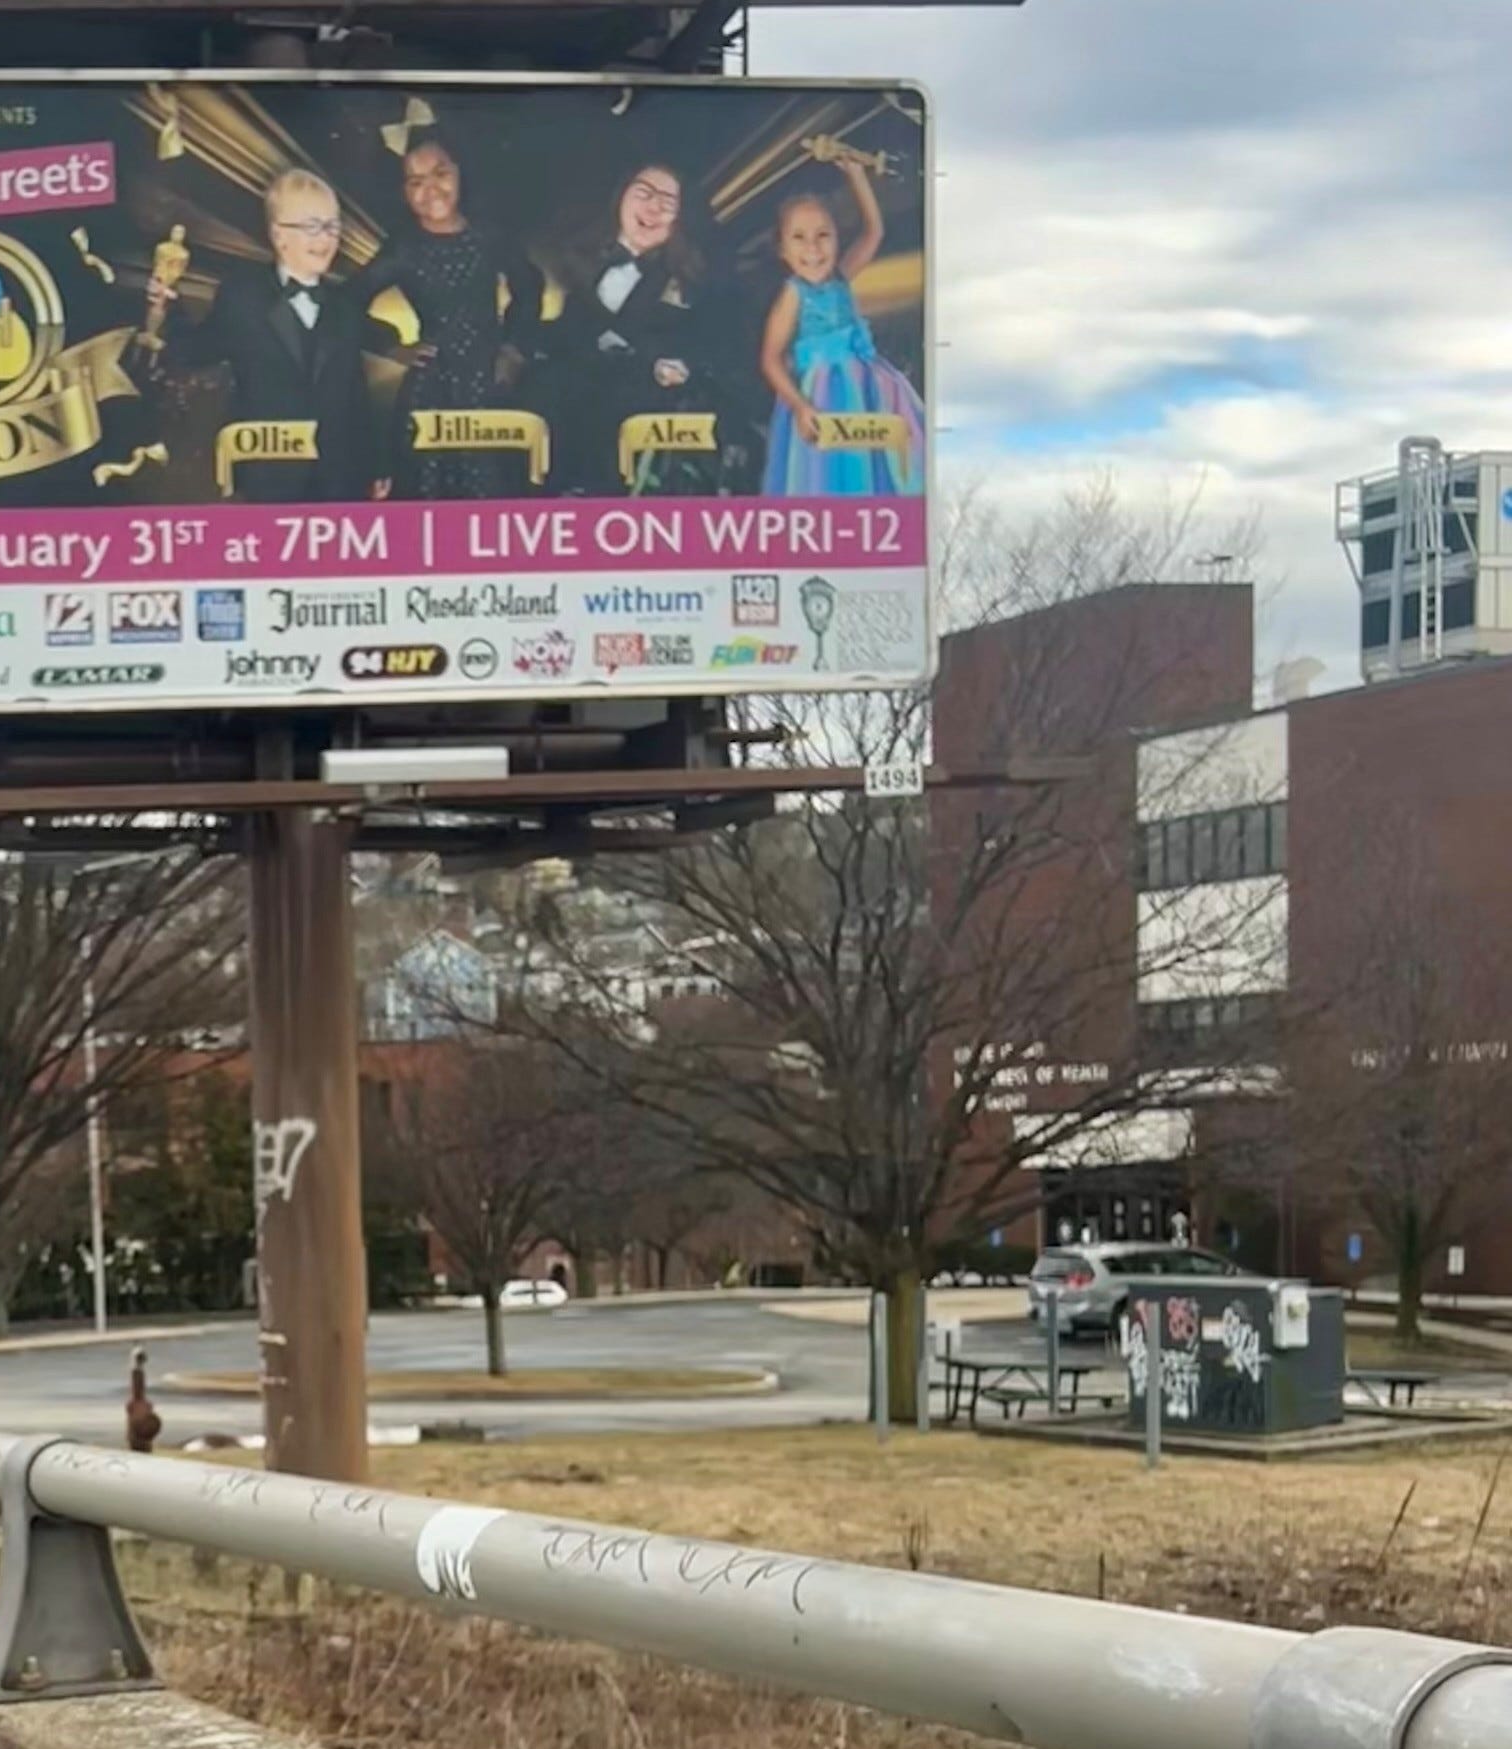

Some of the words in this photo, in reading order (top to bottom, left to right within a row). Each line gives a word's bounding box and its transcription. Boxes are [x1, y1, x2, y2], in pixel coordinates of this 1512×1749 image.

[234, 426, 304, 455] Ollie
[427, 413, 526, 445] Jilliana
[641, 418, 701, 446] Alex
[831, 417, 890, 443] Xoie
[128, 519, 209, 566] 31ST
[224, 535, 260, 563] at
[276, 516, 388, 561] 7PM
[469, 511, 578, 557] LIVE
[594, 509, 682, 554] ON
[701, 508, 902, 554] WPRI-12
[111, 595, 179, 628] FOX
[268, 587, 387, 633] Journal
[405, 586, 478, 624] Rhode
[481, 582, 559, 618] Island
[583, 587, 704, 614] withum
[40, 667, 151, 684] LAMAR
[225, 650, 321, 683] johnny
[388, 650, 438, 674] HJY
